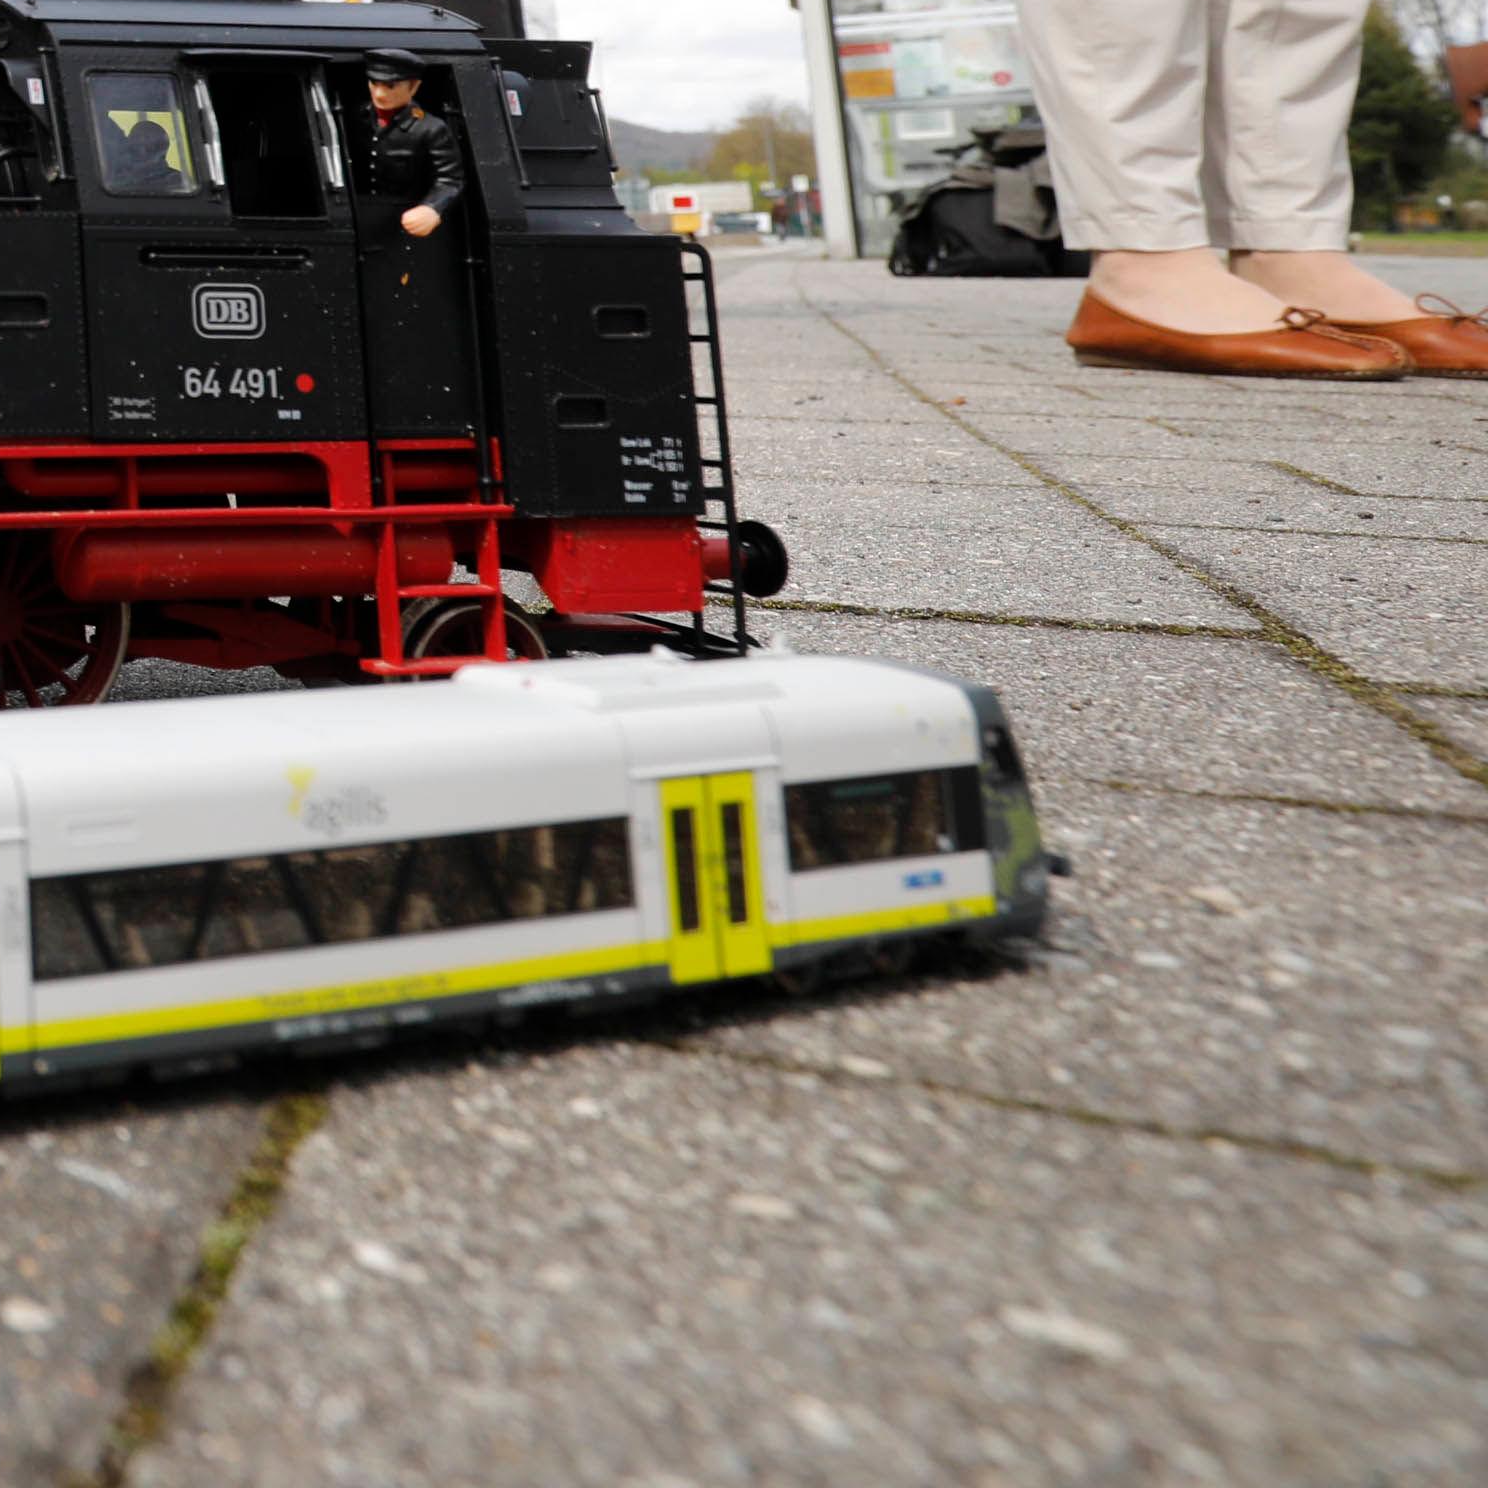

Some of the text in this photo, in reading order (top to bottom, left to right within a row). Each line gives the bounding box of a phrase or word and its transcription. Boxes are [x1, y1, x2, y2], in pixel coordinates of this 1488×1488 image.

[206, 298, 250, 324] DB
[184, 367, 278, 399] 64 491
[305, 785, 389, 839] agilis
